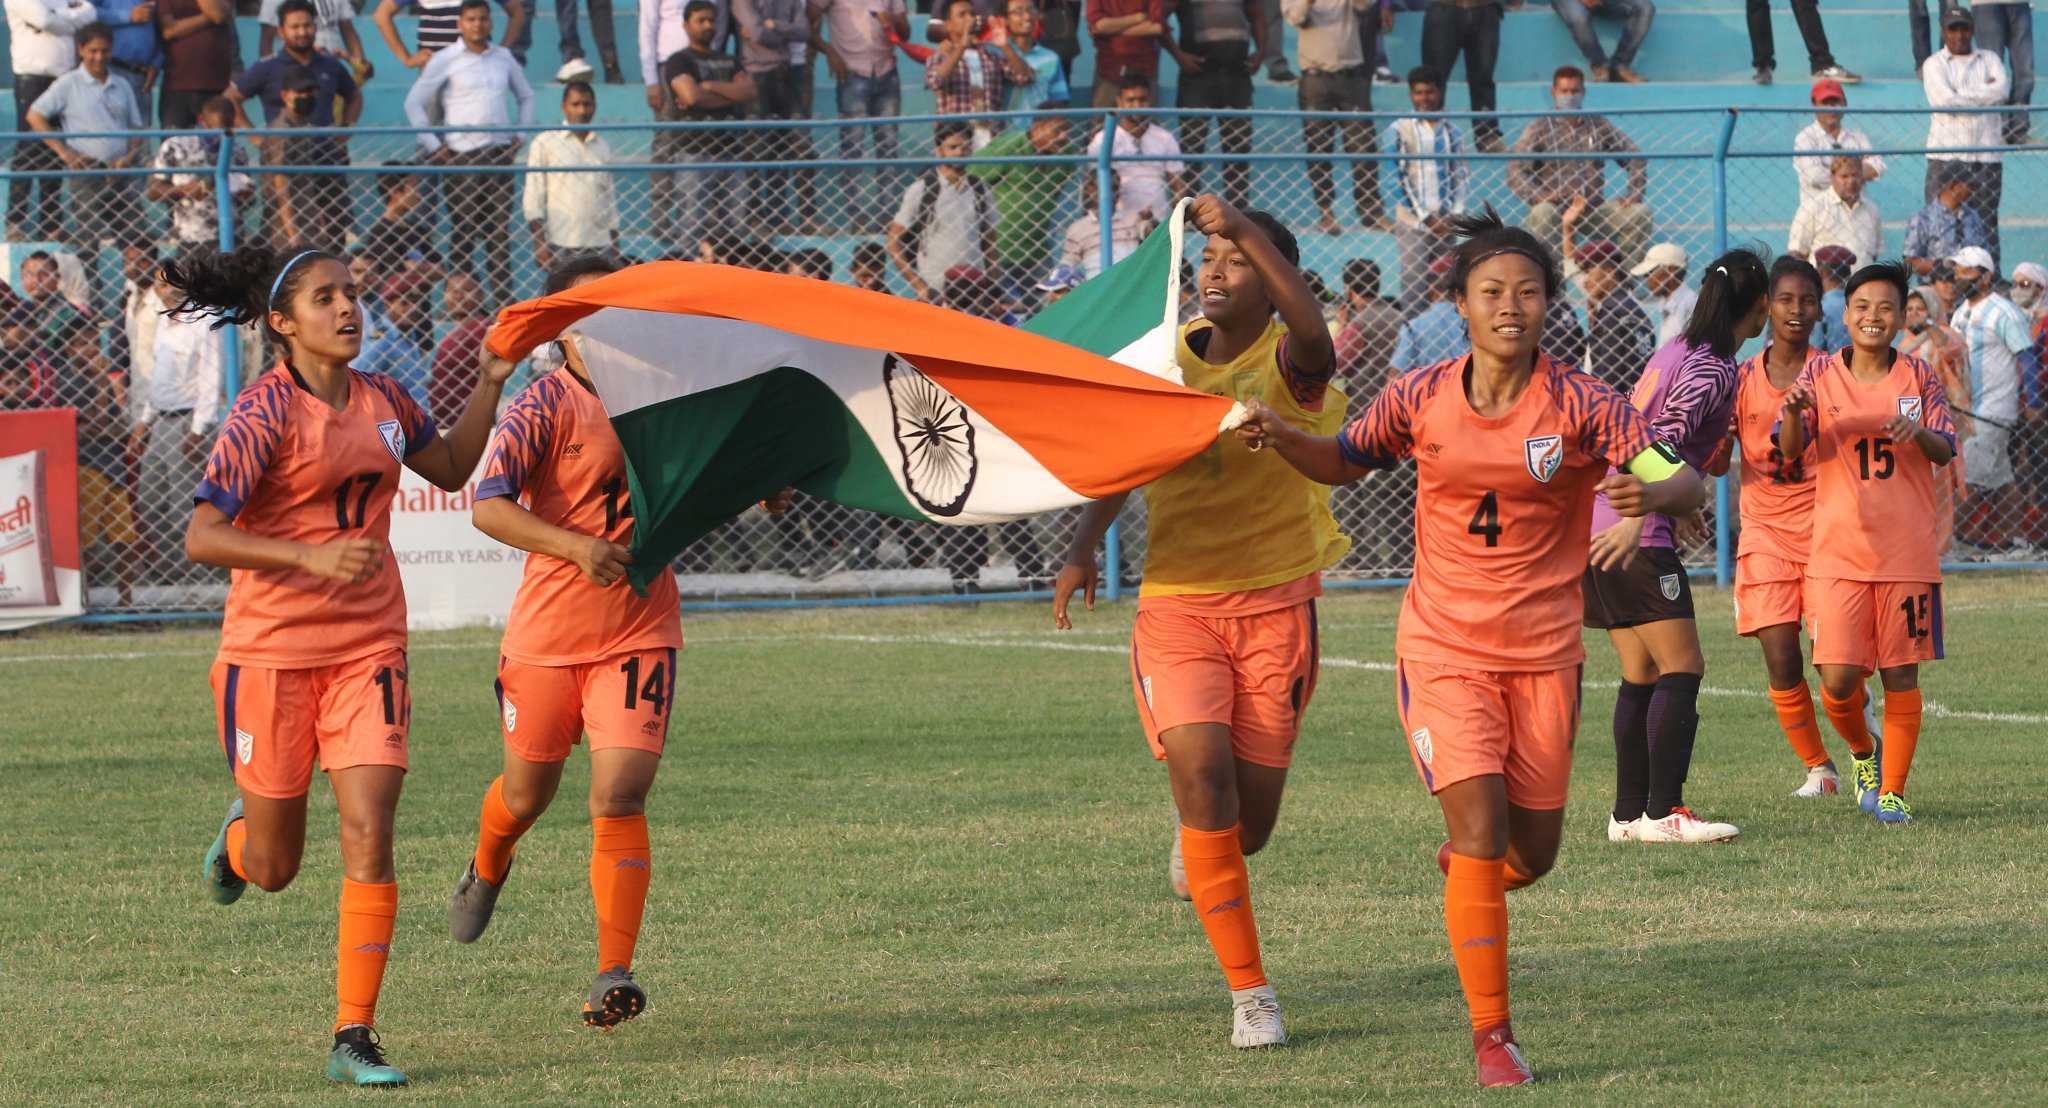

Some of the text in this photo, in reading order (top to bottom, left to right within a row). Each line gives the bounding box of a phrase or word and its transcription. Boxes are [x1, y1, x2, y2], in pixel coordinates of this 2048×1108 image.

[1531, 441, 1551, 449] INDIA
[1854, 437, 1895, 480] 15
[334, 472, 383, 530] 17
[1468, 491, 1502, 547] 4
[459, 549, 503, 563] YEARS
[621, 656, 665, 716] 14
[1655, 823, 1684, 840] adidas
